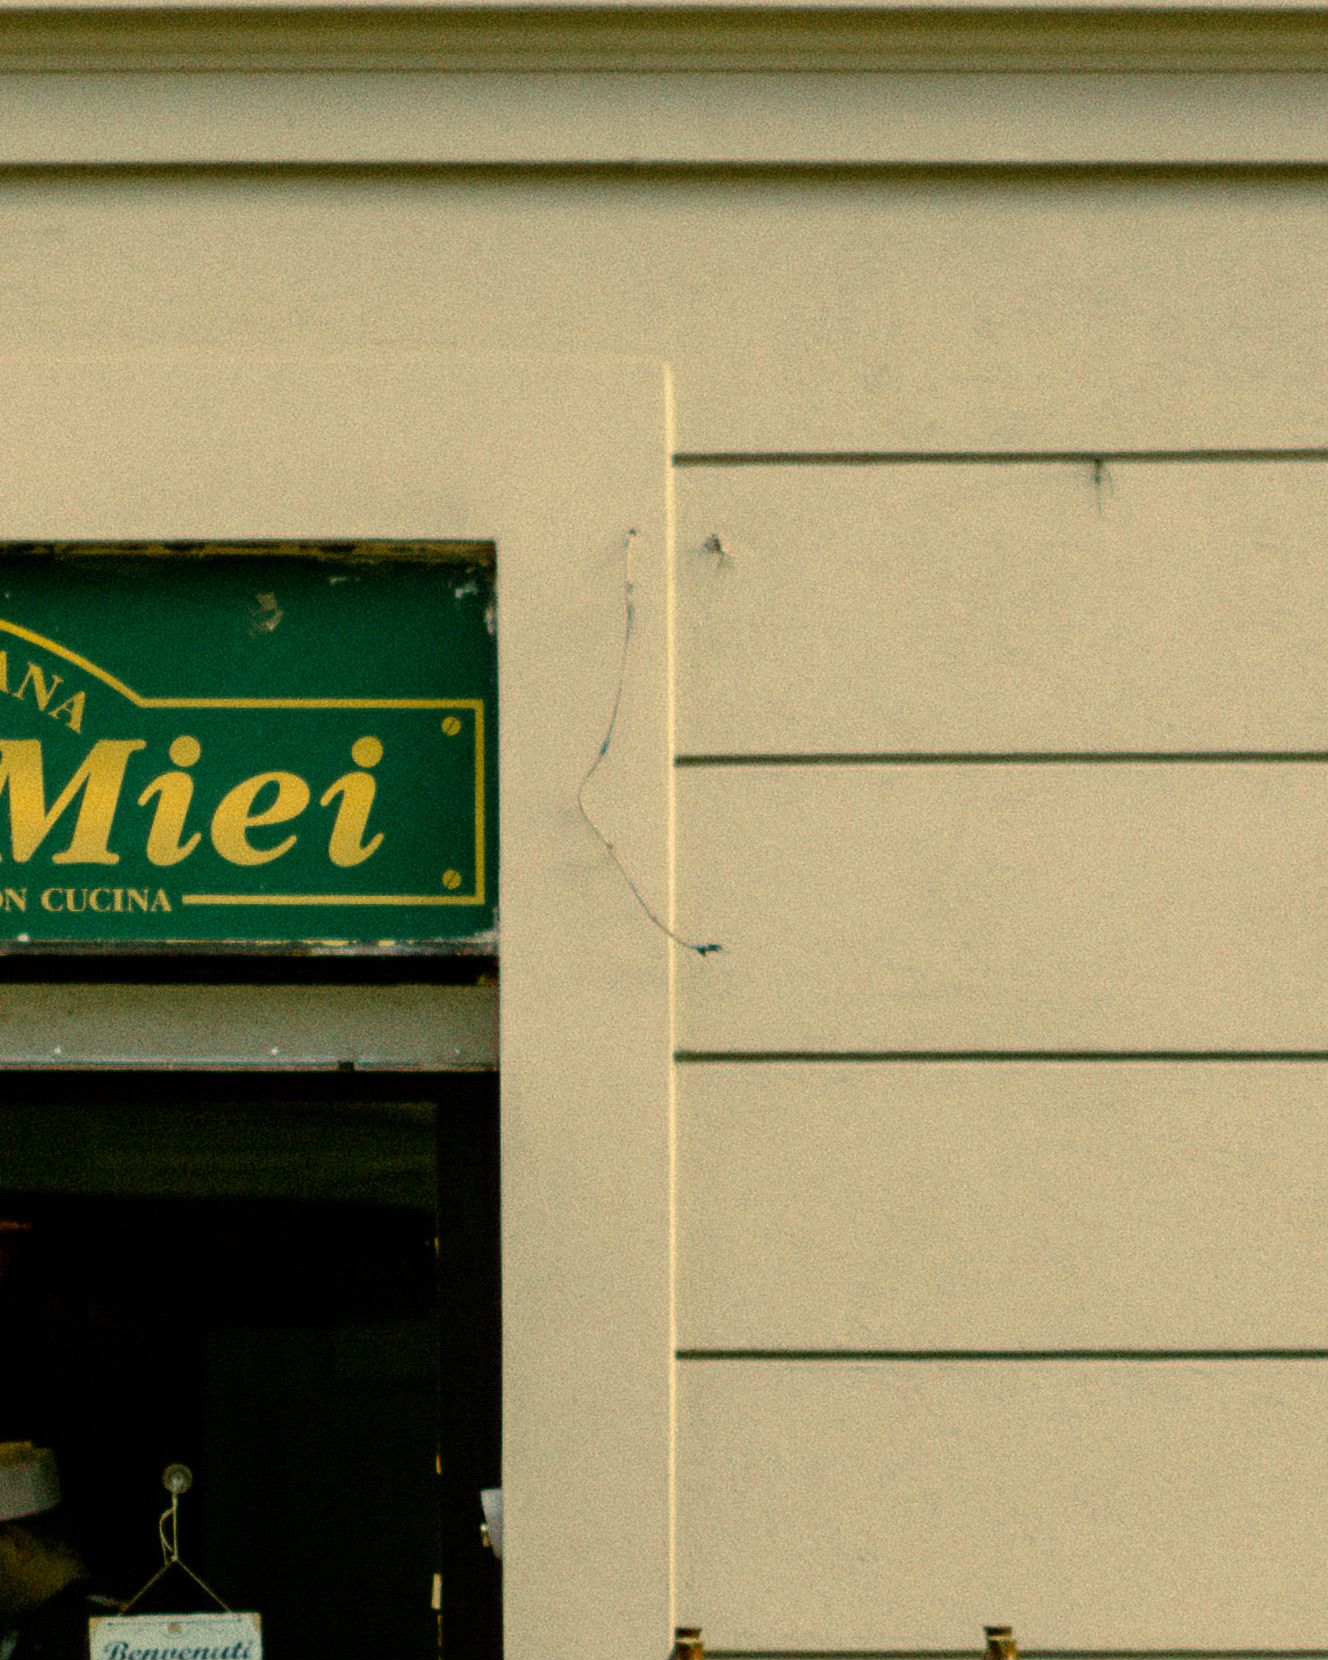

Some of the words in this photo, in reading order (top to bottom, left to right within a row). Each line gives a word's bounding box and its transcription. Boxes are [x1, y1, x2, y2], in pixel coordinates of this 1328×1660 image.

[0, 734, 385, 868] Miei
[0, 887, 27, 913] N
[40, 887, 173, 913] CUCINA
